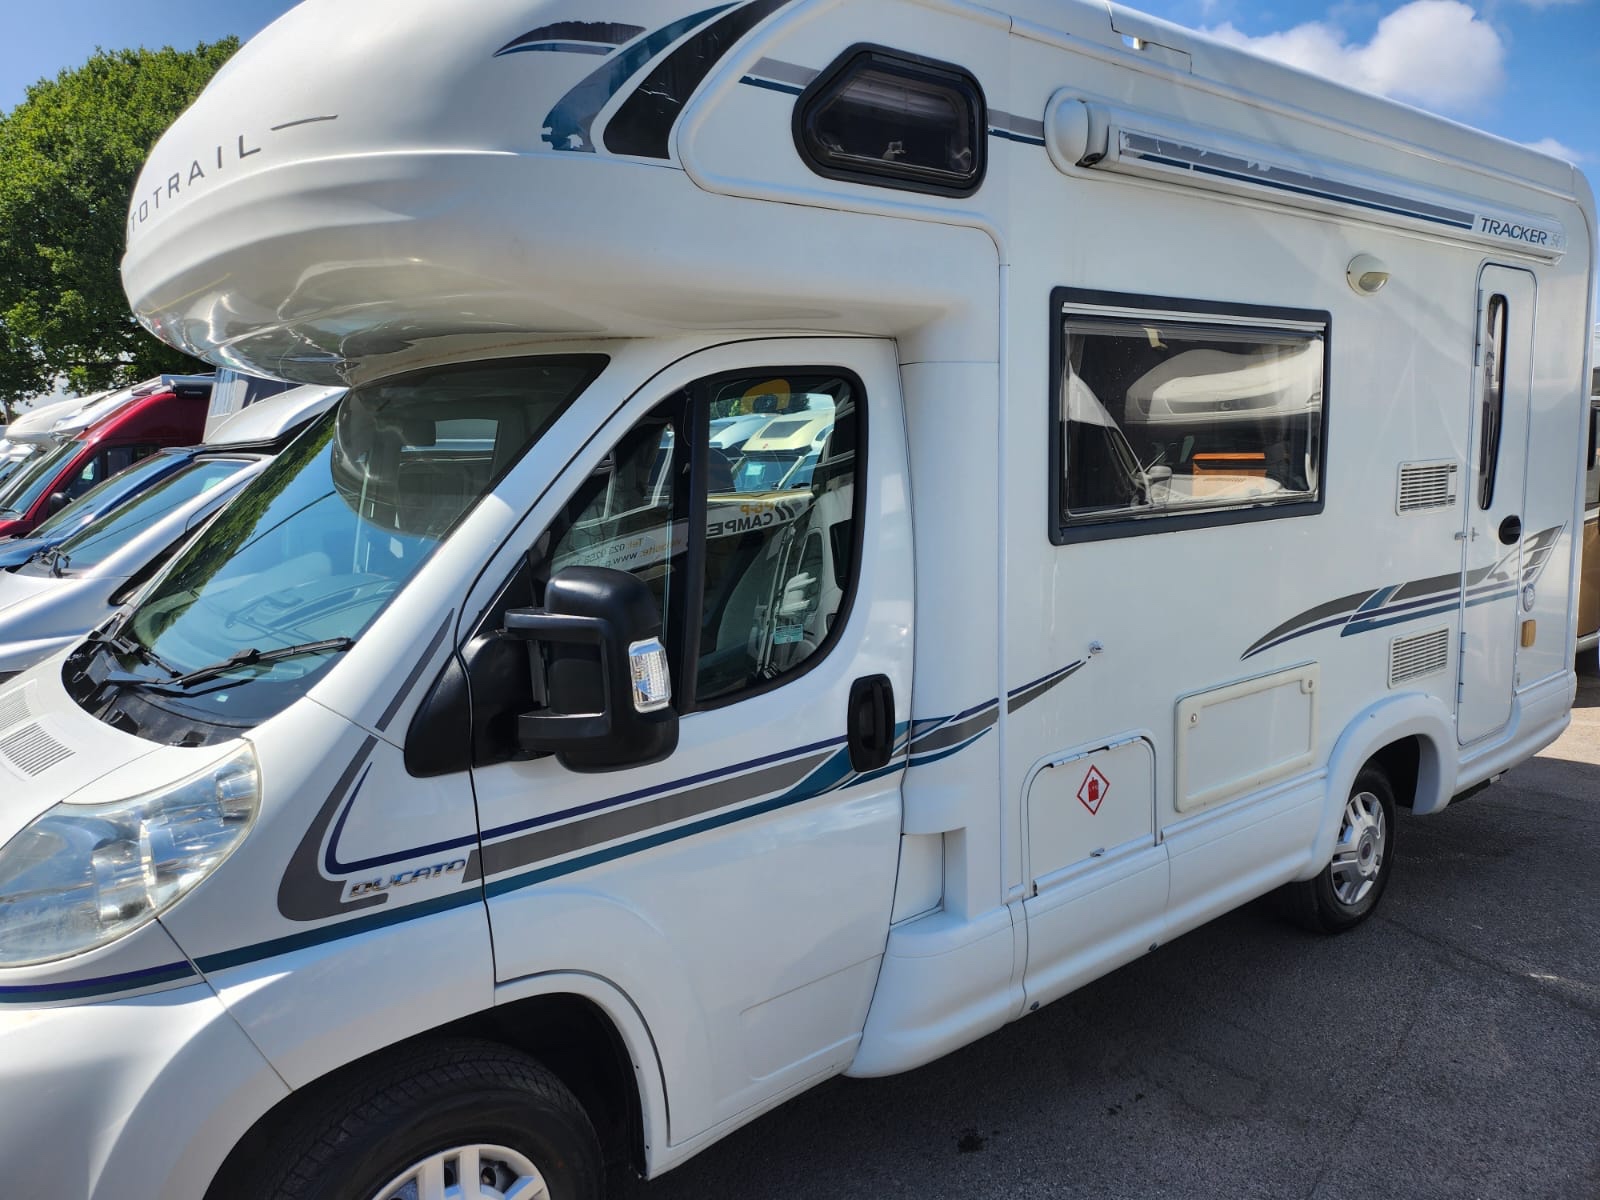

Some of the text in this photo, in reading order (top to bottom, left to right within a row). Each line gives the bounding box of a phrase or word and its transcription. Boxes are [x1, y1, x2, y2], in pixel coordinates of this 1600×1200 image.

[128, 135, 261, 236] TOTRAIL
[1481, 218, 1548, 245] TRACKER
[350, 859, 466, 897] DUCATO
